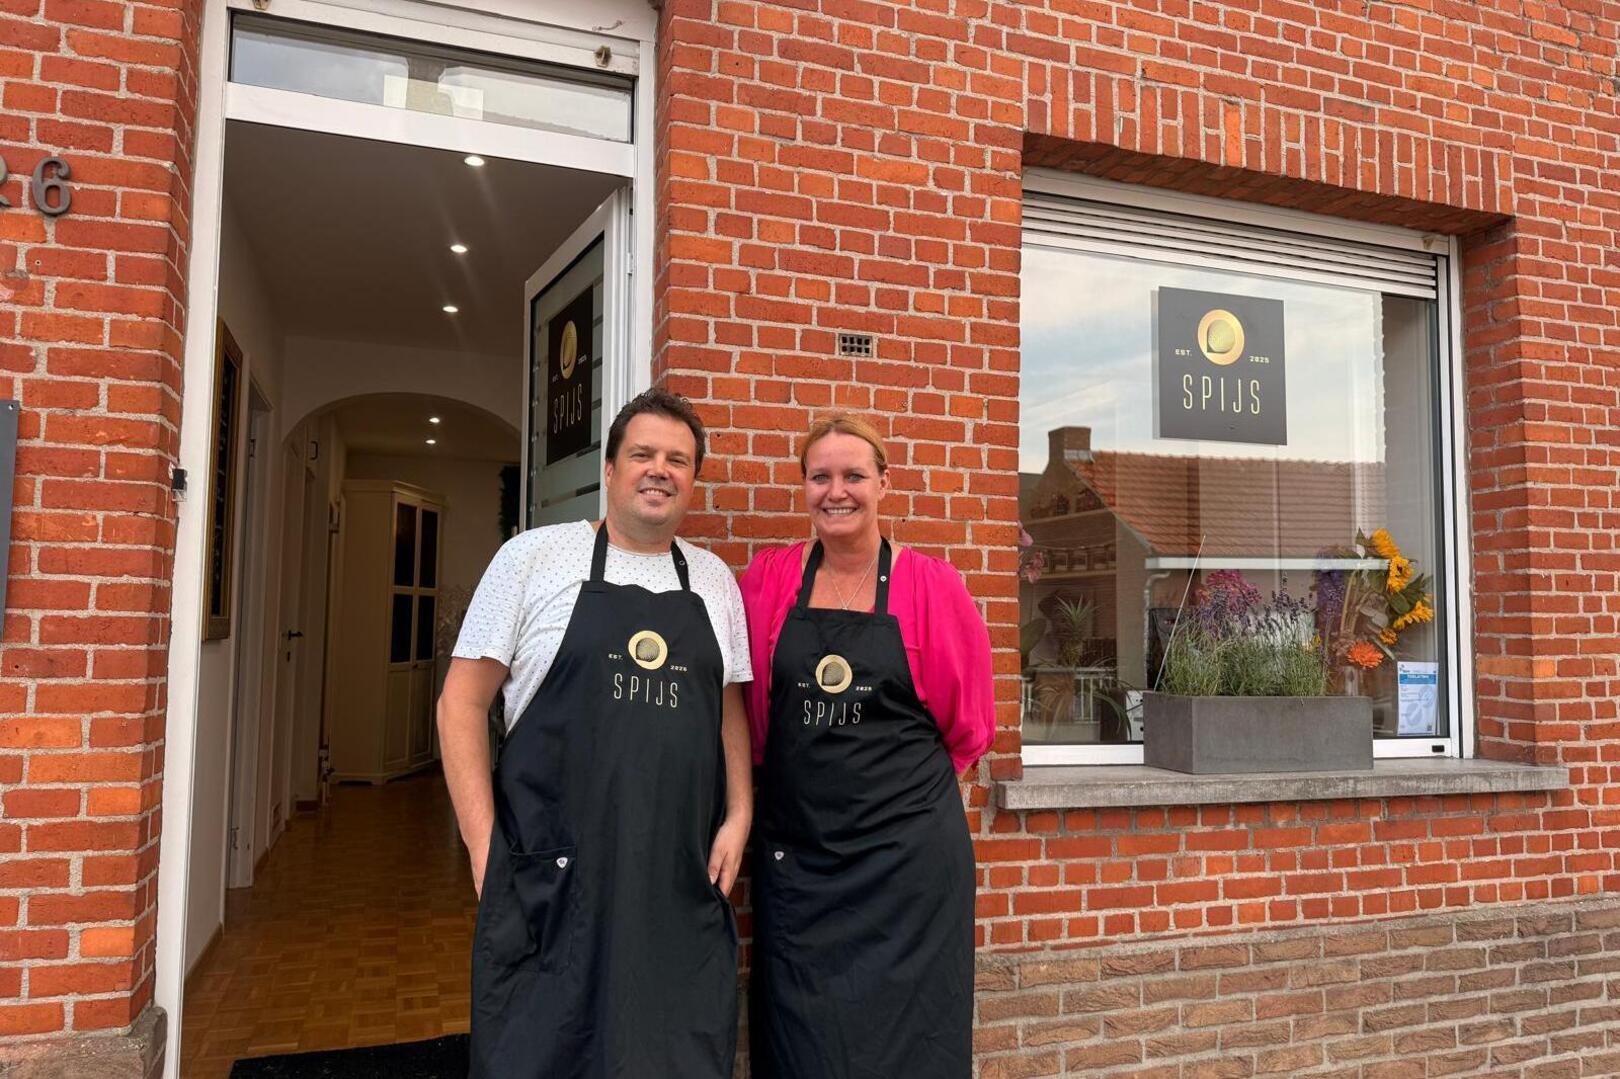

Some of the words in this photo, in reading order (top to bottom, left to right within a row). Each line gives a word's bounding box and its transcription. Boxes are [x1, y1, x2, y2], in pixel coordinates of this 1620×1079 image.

[1175, 348, 1193, 357] EST.
[553, 383, 582, 434] SPIJS
[1183, 374, 1260, 414] SPIJS
[613, 673, 678, 708] SPIJS
[803, 699, 862, 727] SPIJS
